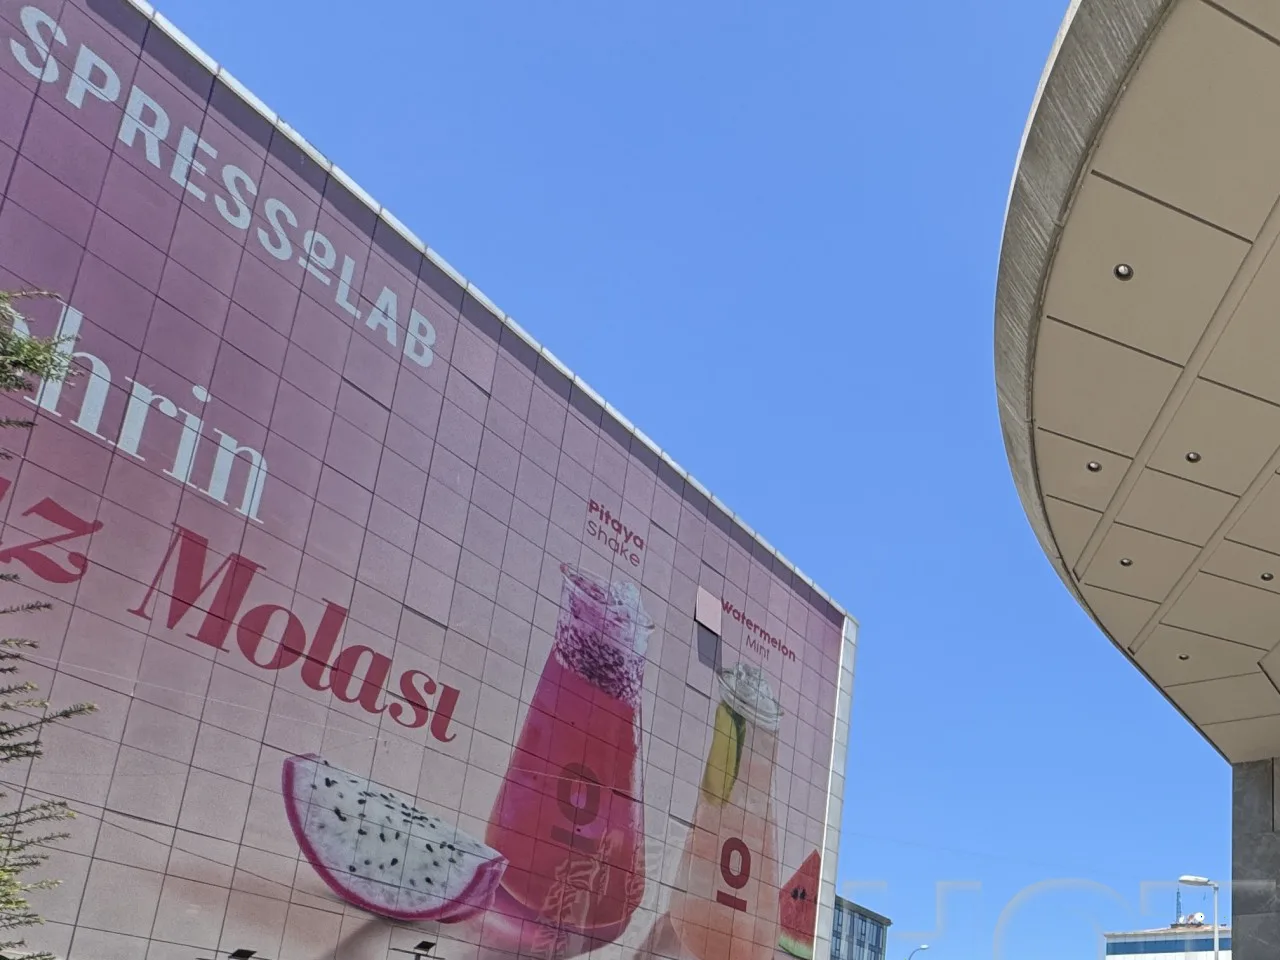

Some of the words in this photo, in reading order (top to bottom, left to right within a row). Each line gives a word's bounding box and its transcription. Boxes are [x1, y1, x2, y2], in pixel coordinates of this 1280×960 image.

[10, 299, 271, 524] hrin
[586, 520, 640, 567] Shake
[588, 498, 644, 551] Pitaya
[721, 598, 796, 662] Watermelon
[745, 635, 770, 661] Mint
